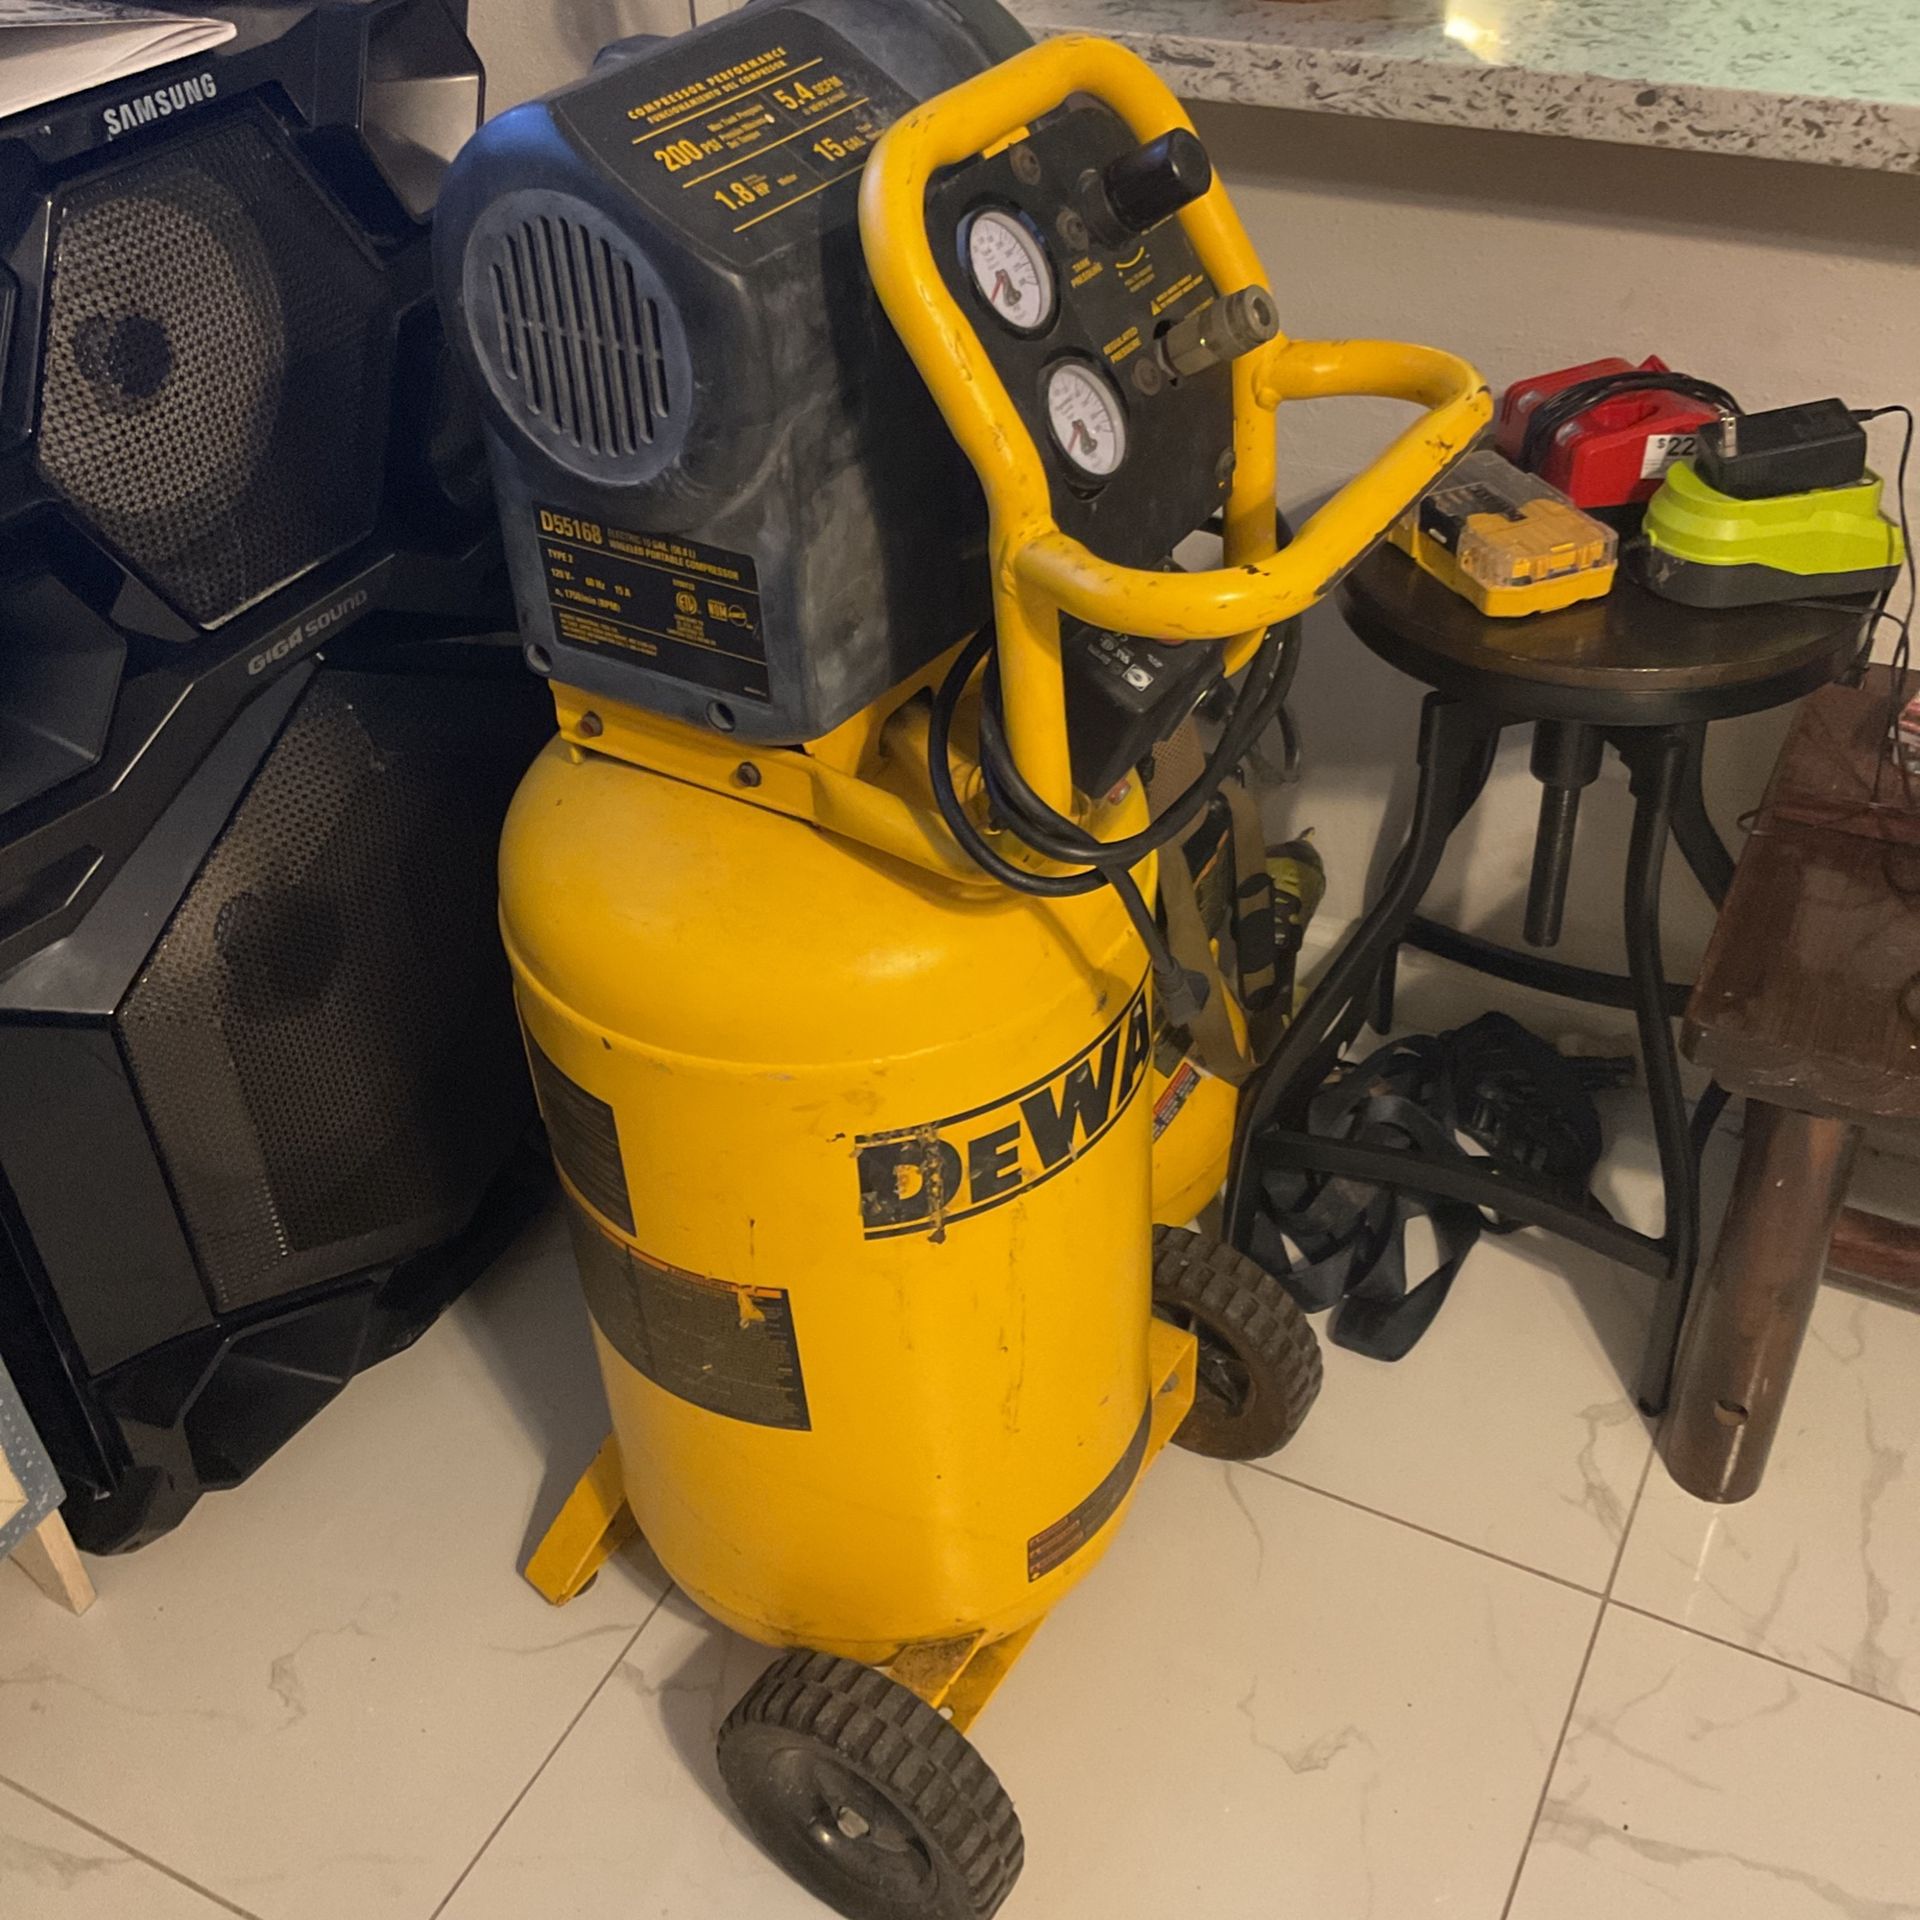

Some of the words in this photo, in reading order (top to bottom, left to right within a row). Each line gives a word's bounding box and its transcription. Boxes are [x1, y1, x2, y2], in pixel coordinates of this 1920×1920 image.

[627, 82, 706, 120] COMPRESSOR
[705, 46, 788, 87] PERFORMANCE
[773, 82, 816, 110] 5.4
[103, 73, 217, 135] SAMSUNG
[653, 139, 704, 172] 200
[702, 140, 723, 155] PSI
[813, 137, 847, 162] 15
[713, 181, 756, 211] 1.8
[539, 511, 602, 544] D55168
[248, 626, 303, 675] GIGA
[305, 590, 368, 638] SOUND
